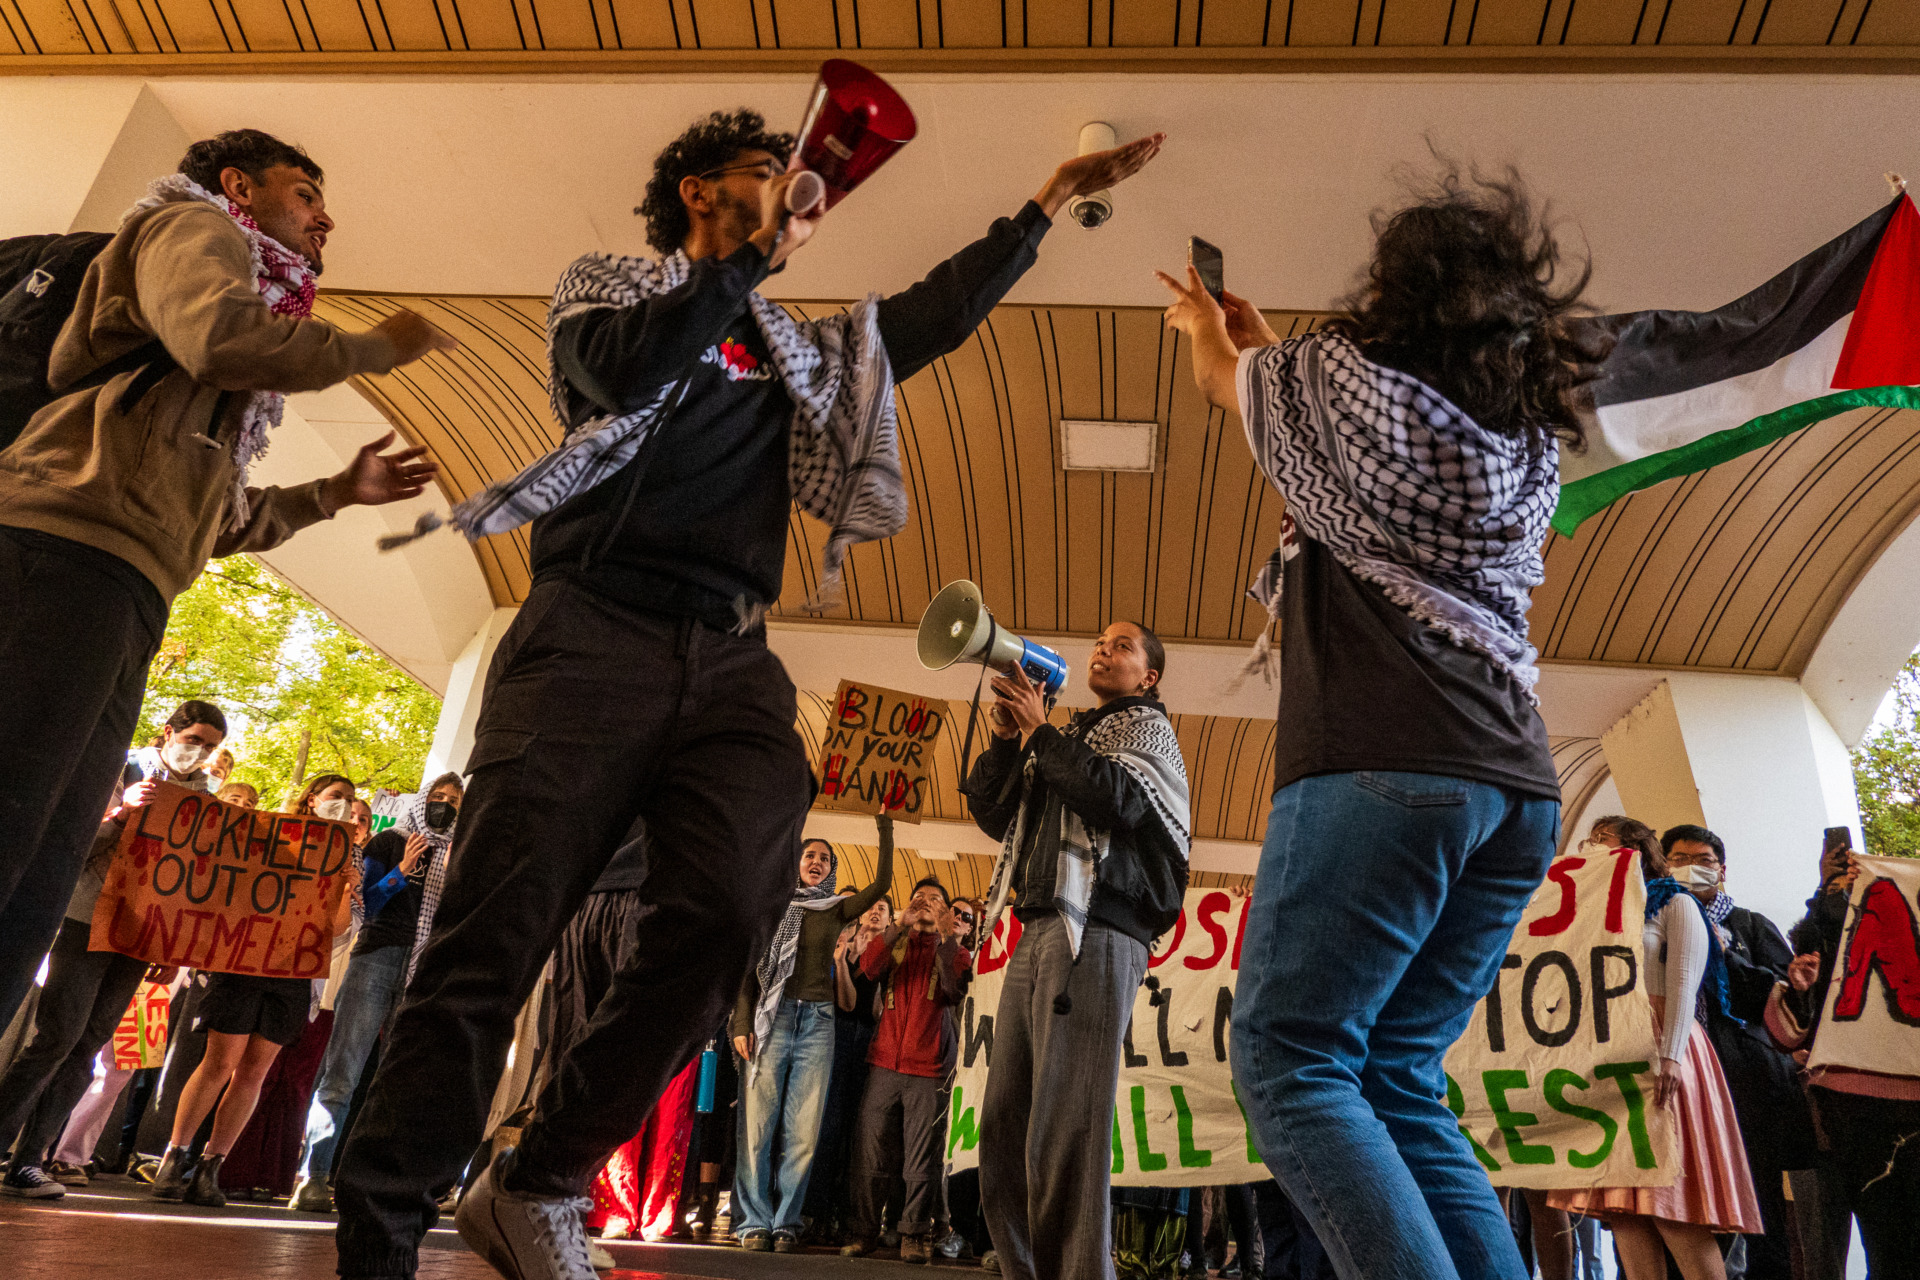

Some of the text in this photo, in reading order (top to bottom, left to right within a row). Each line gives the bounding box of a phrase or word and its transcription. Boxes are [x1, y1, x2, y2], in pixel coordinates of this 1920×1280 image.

[839, 688, 942, 742] BLOOD
[820, 752, 927, 813] HANDS
[856, 736, 923, 768] YOUR
[136, 795, 350, 877] LOCKHEED
[153, 853, 313, 915] OUT OF
[108, 897, 324, 977] UNIMELB
[1485, 945, 1638, 1053] TOP
